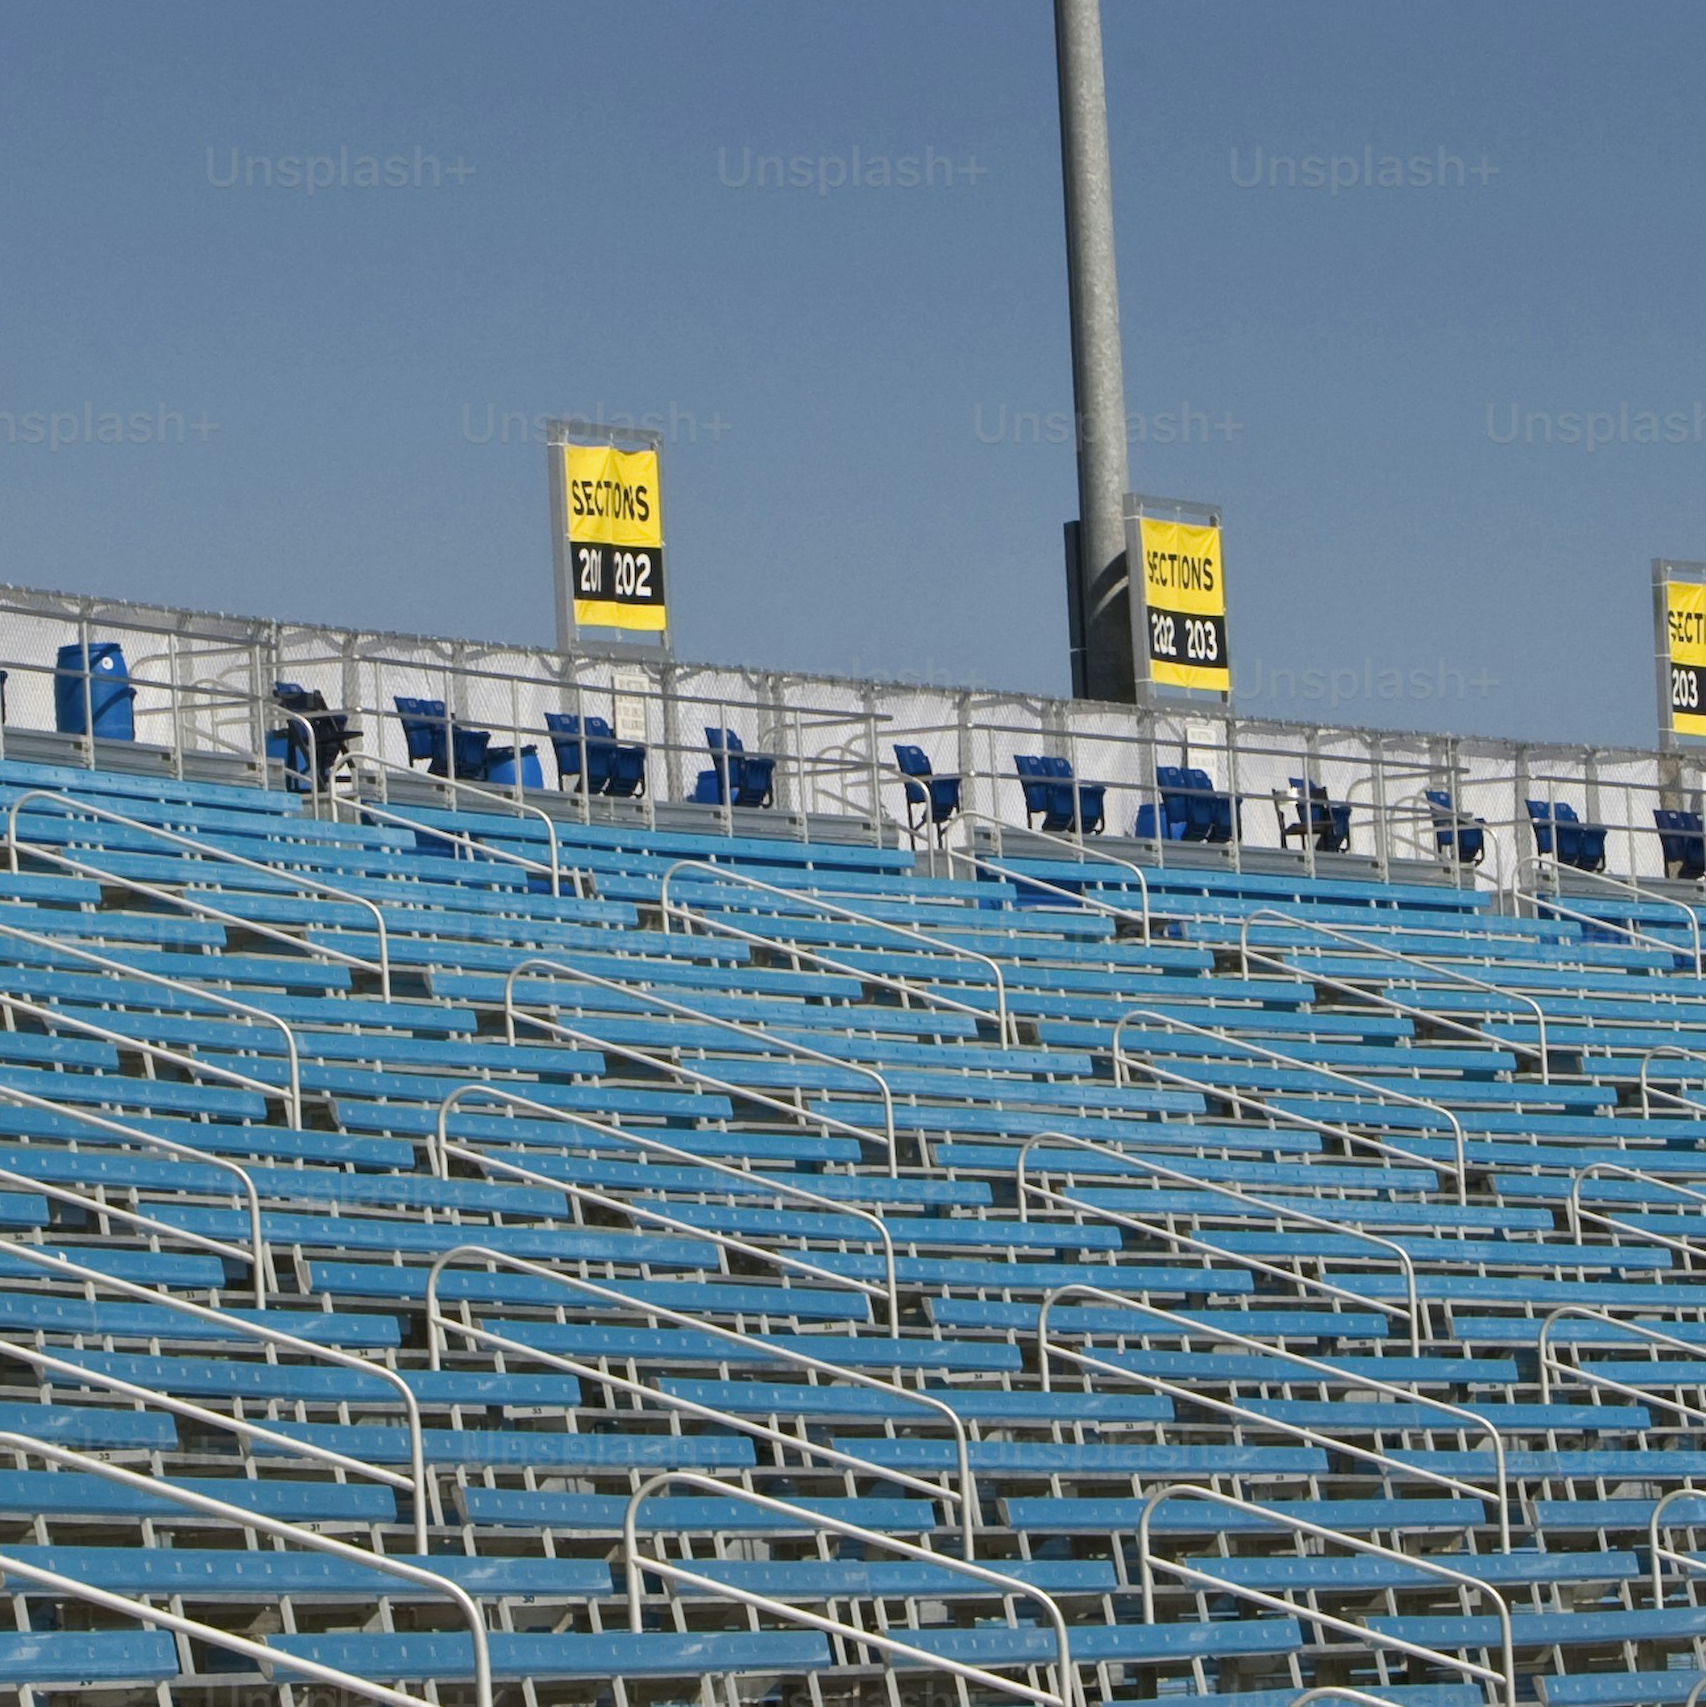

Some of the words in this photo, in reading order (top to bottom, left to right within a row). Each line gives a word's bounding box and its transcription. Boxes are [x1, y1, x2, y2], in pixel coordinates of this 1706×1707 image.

[578, 548, 602, 592] 201
[614, 551, 652, 597] 202
[1147, 550, 1214, 592] SECTIONS
[1151, 613, 1177, 656] 202
[1185, 619, 1218, 661] 203
[1672, 668, 1698, 708] 203
